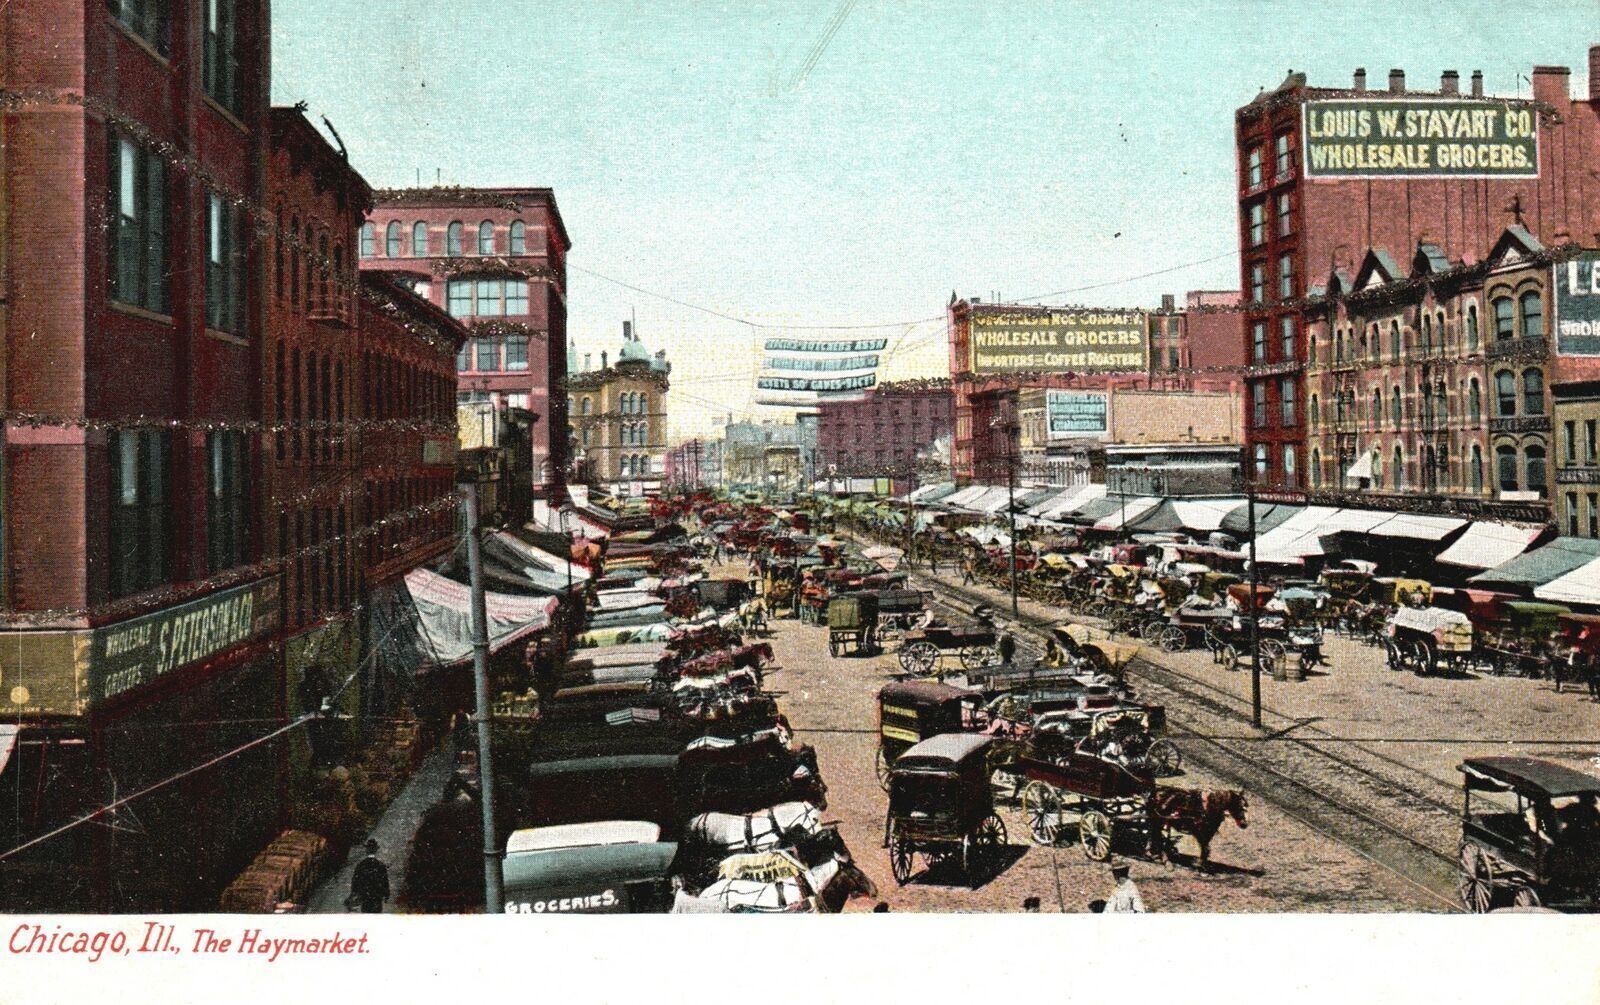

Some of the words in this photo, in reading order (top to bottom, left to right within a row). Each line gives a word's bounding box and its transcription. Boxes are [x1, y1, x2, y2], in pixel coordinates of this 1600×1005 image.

[1310, 109, 1371, 138] LOUIS
[1376, 109, 1403, 138] W.
[1405, 109, 1498, 138] STAYART
[1505, 109, 1536, 139] CO.
[1310, 144, 1430, 169] WHOLESALE
[1436, 143, 1533, 168] GROCERS.
[975, 331, 1058, 346] WHOLESALE
[1065, 330, 1141, 345] GROCERS
[977, 352, 1034, 367] IMPORTERS
[1044, 352, 1085, 366] COFFEE
[1088, 352, 1143, 366] ROASTERS
[105, 623, 152, 658] WHOLESALE
[504, 889, 619, 914] GROCERIES.
